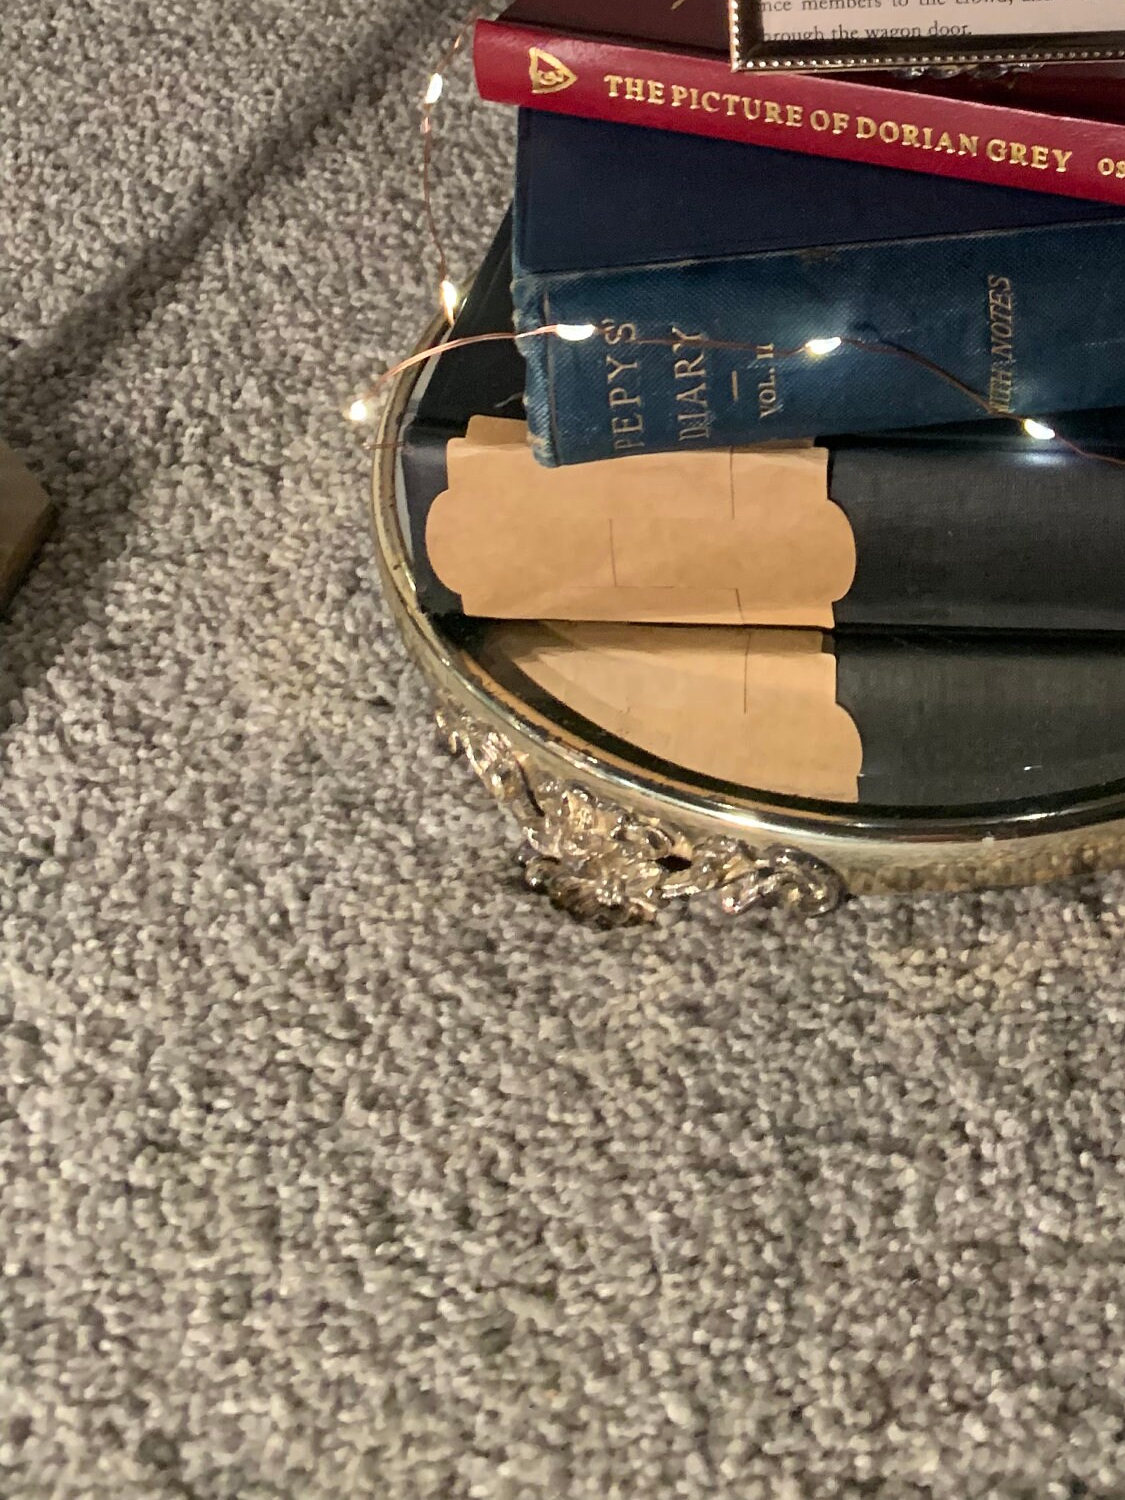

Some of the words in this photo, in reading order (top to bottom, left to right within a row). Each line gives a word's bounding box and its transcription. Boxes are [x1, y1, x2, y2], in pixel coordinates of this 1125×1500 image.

[832, 24, 858, 40] the
[928, 20, 972, 37] door.
[604, 74, 665, 105] THE
[671, 84, 803, 127] PICTURE
[810, 109, 849, 134] OF
[856, 116, 980, 157] DORIAN
[986, 138, 1073, 172] GREY
[987, 274, 1013, 362] NOTES
[671, 326, 711, 442] DIARY
[757, 366, 784, 419] VOL.
